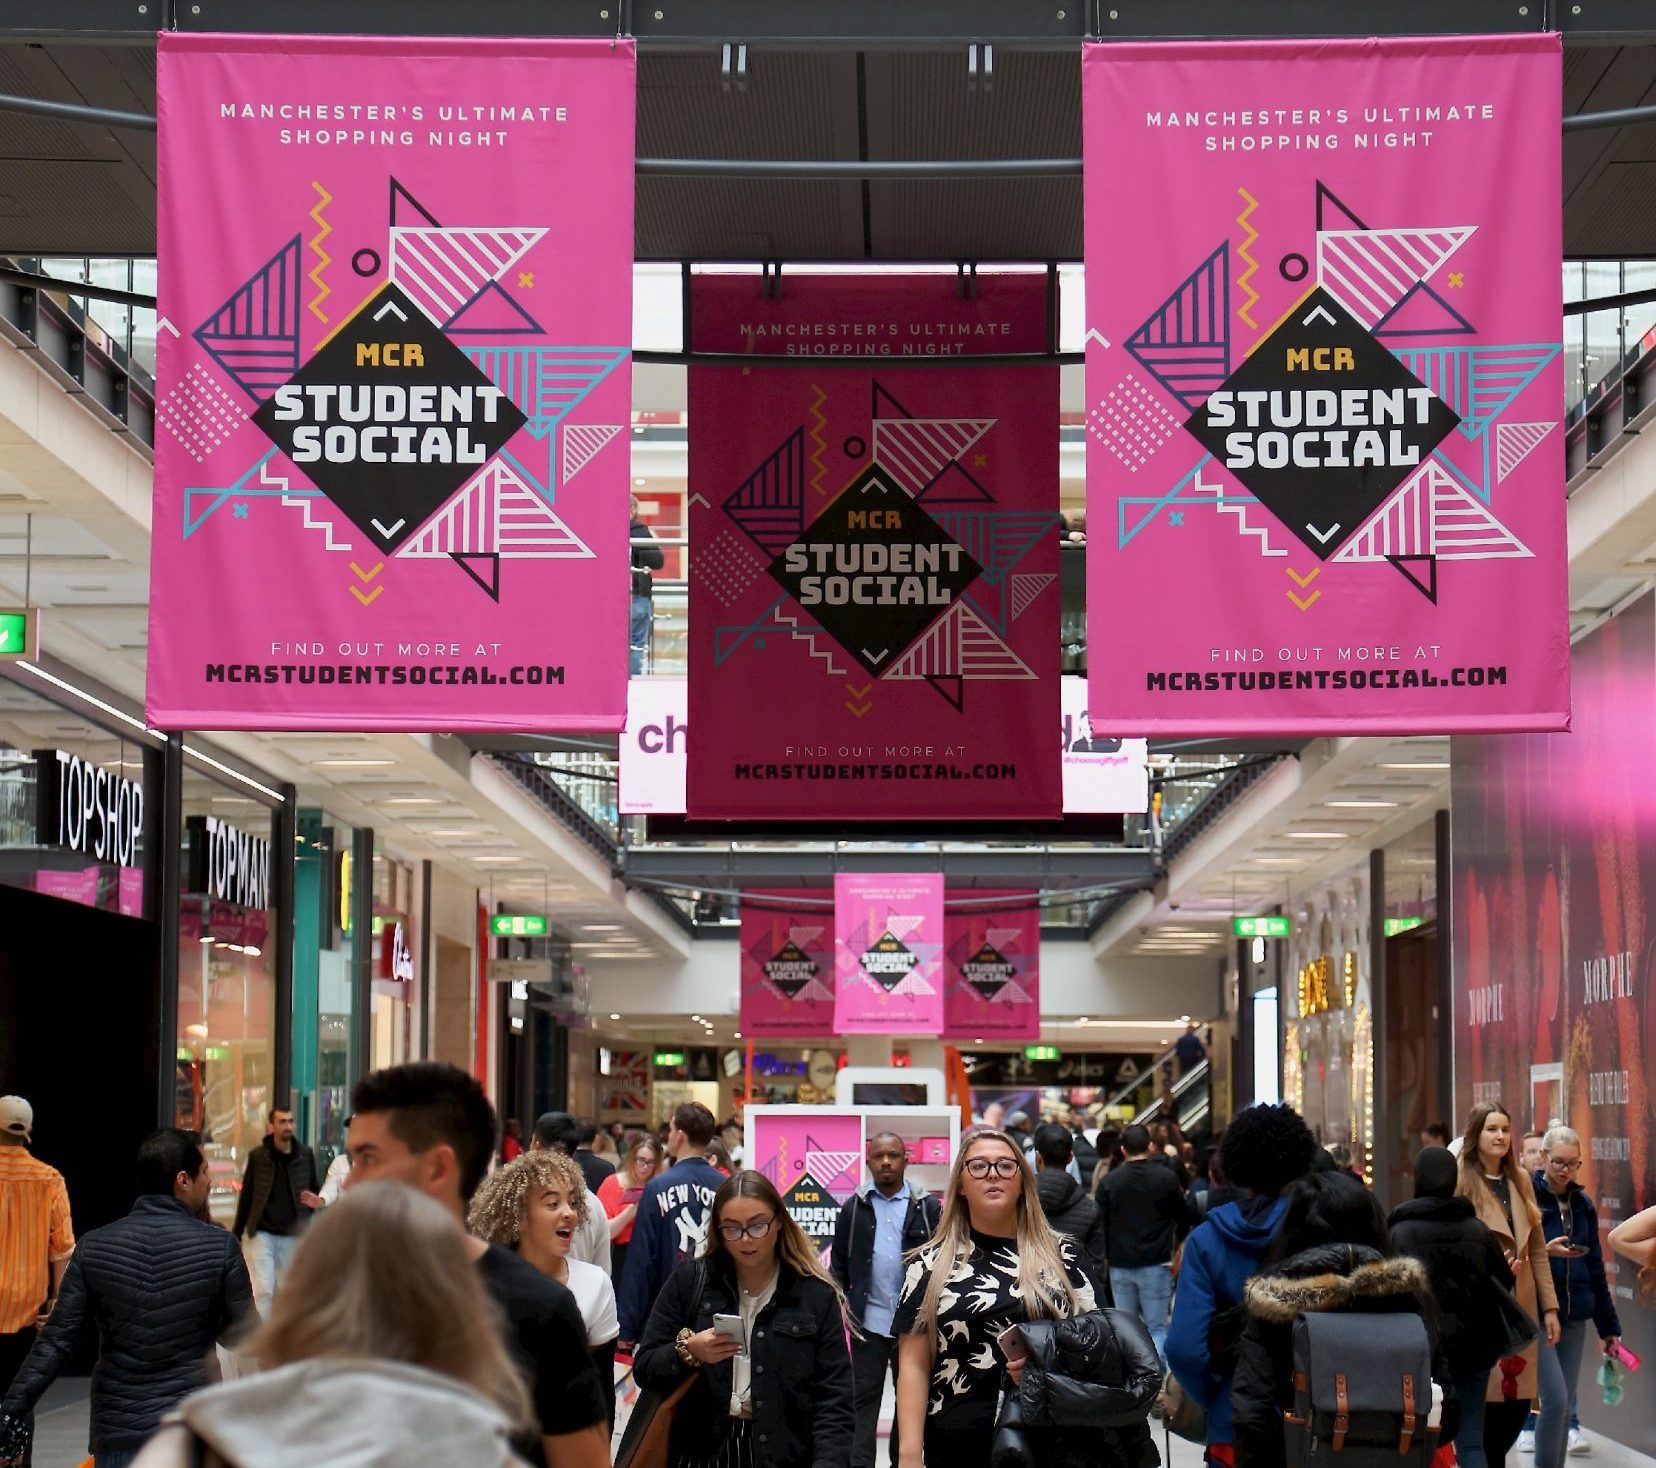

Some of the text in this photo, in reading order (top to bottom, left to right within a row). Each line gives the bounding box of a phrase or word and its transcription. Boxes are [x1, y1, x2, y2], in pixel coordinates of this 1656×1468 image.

[220, 103, 568, 122] MANCHESTER'S ULTIMATE
[1146, 104, 1495, 127] MANCHESTER'S ULTIMATE
[279, 129, 508, 146] SHOPPING NIGHT
[1205, 132, 1433, 151] SHOPPING NIGHT
[740, 323, 1012, 337] MANCHESTER'S ULTIMATE
[356, 343, 424, 366] MCR
[786, 342, 965, 357] SHOPPING NIGHT
[1286, 347, 1354, 371] MCR
[274, 385, 503, 422] STUDENT
[1206, 387, 1437, 428] STUDENT
[292, 426, 486, 463] SOCIAL
[1225, 430, 1420, 469] SOCIAL
[847, 510, 901, 530] MCR
[785, 543, 965, 573] STUDENT
[799, 576, 951, 605] SOCIAL
[271, 641, 501, 657] FIND OUT MORE AT
[1210, 645, 1441, 662] FIND OUT MORE AT
[205, 664, 565, 685] MCRSTUDENTSOCIAL.COM
[1146, 666, 1507, 691] MCRSTUDENTSOCIAL.COM
[785, 746, 966, 758] FIND OUT MORE AT
[735, 764, 1016, 780] MCRSTUDENTSOCIAL.COM
[55, 750, 143, 867] TOPSHOP
[205, 816, 270, 910] TOPMAN
[862, 952, 915, 963] STUDENT
[866, 962, 912, 973] SOCIAL
[1584, 951, 1632, 1004] MORPHE
[657, 1184, 688, 1217] NEW
[795, 1192, 819, 1202] MCR
